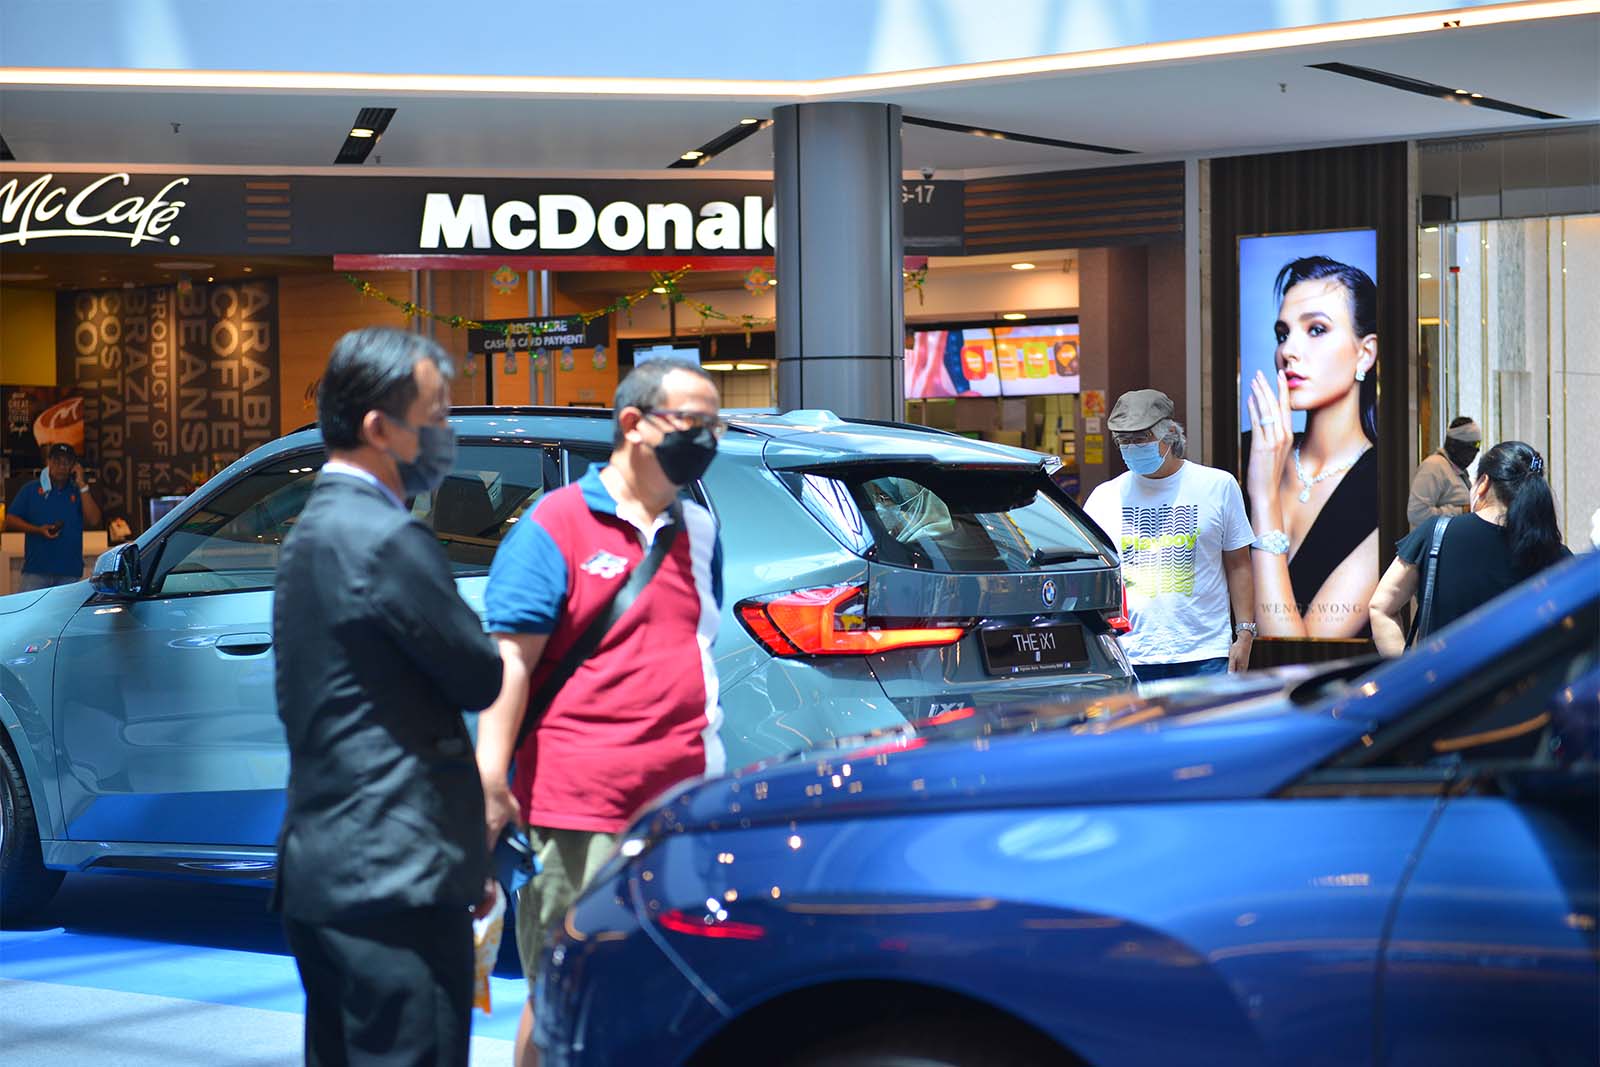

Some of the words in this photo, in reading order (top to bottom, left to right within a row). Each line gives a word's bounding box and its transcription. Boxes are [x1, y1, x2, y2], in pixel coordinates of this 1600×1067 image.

[125, 289, 148, 438] BRAZIL
[151, 288, 168, 412] PRODUCT
[179, 286, 208, 453] BEANS
[242, 284, 271, 454] ARABI
[543, 333, 584, 346] PAYMENT
[152, 419, 168, 455] OF
[1012, 632, 1039, 652] THE
[1039, 631, 1057, 651] iX1
